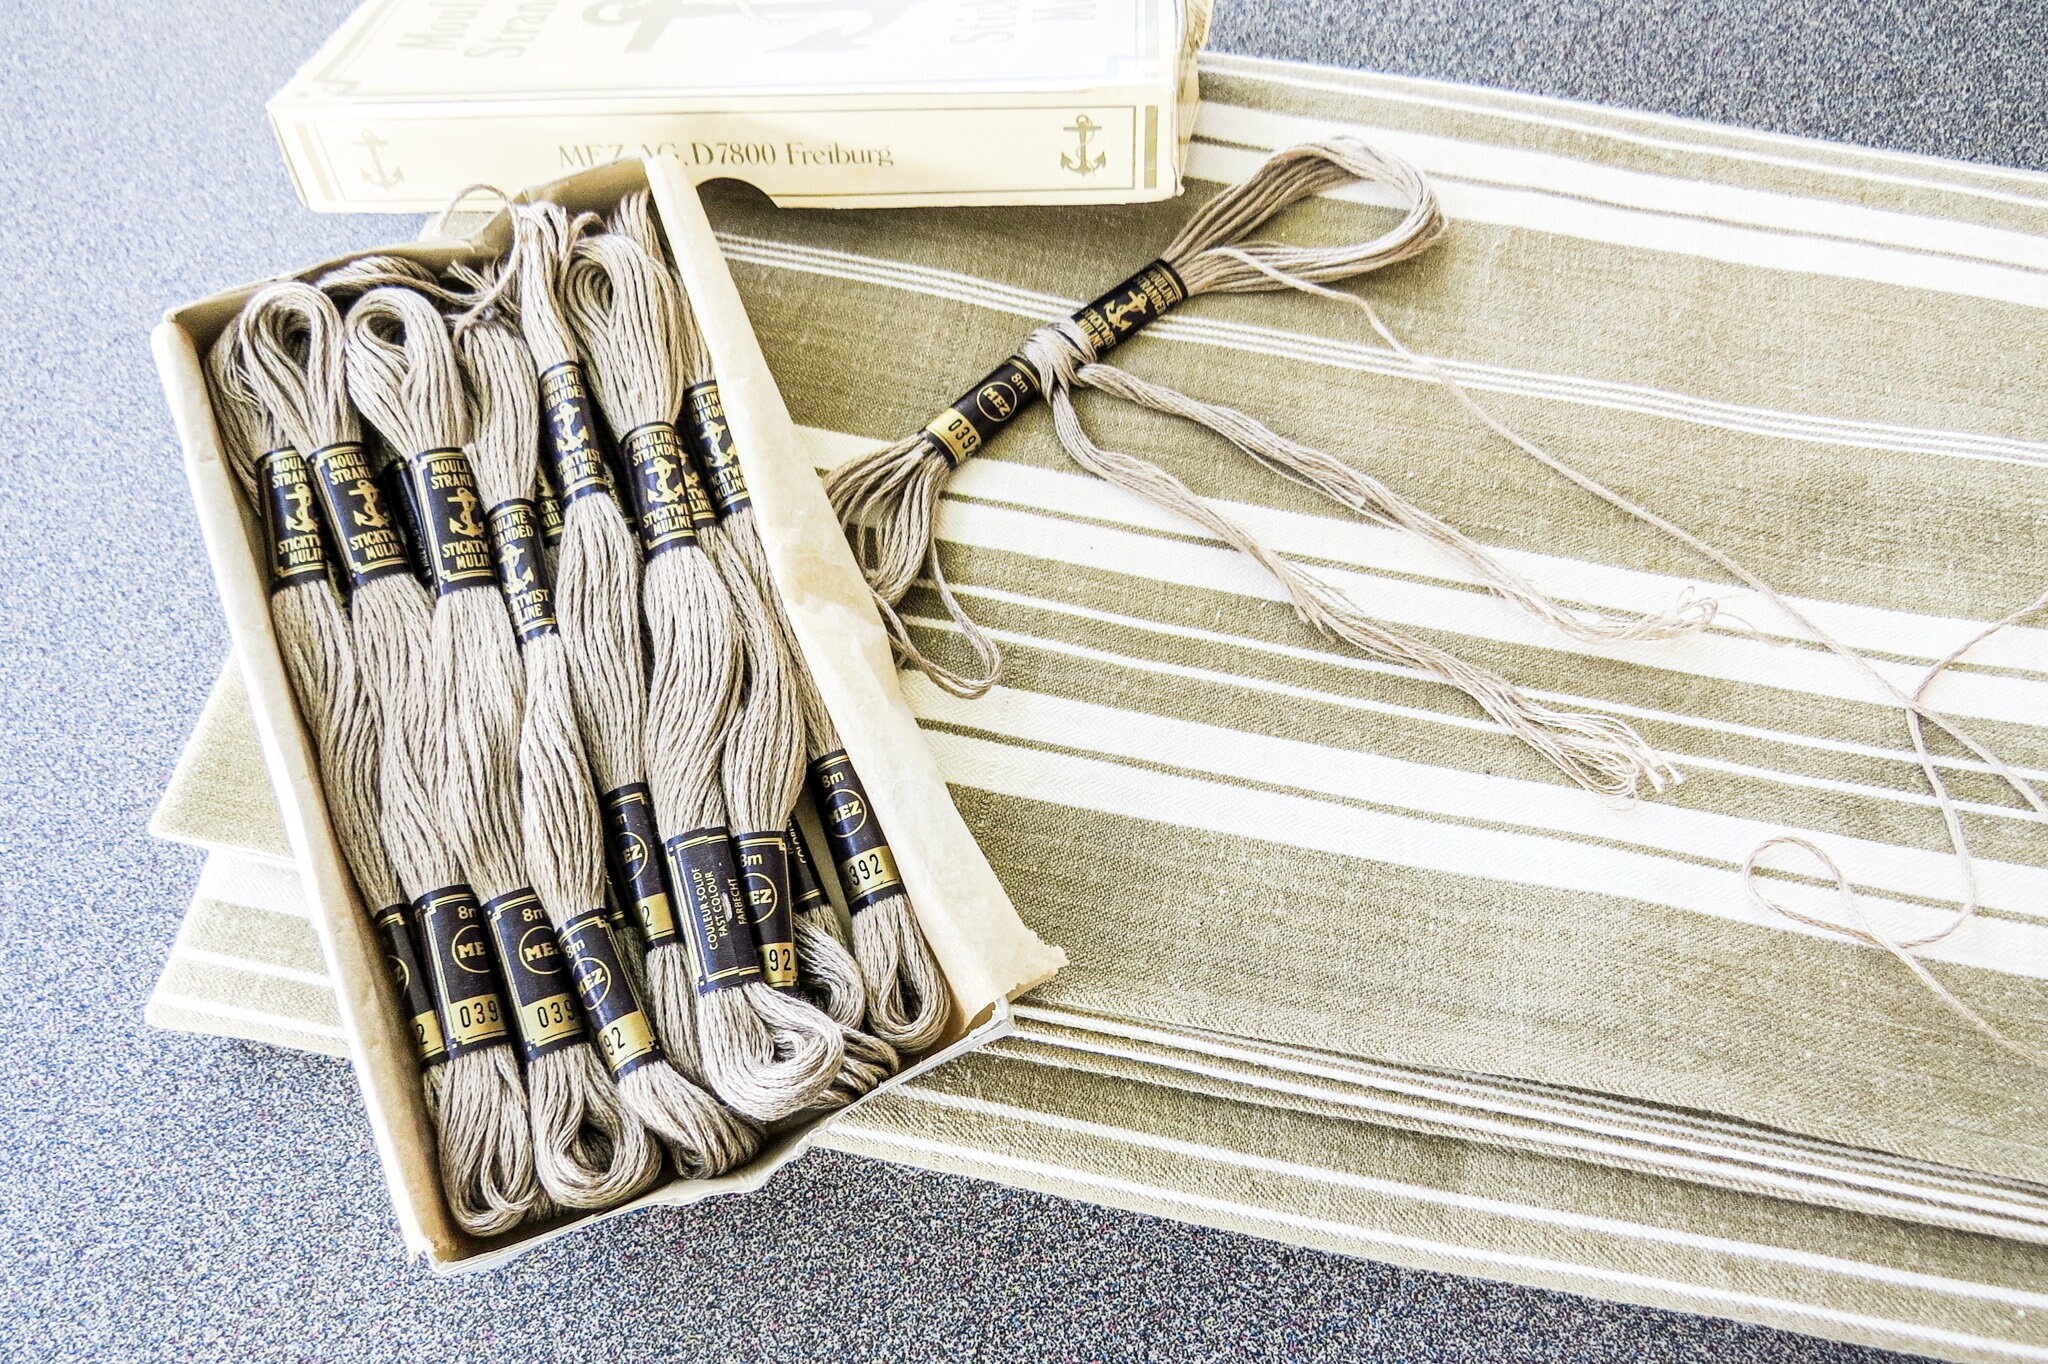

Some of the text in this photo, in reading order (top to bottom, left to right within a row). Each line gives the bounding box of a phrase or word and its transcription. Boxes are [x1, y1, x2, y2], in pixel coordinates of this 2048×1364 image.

[396, 0, 488, 50] Moul
[464, 0, 558, 59] Stran
[692, 141, 777, 167] D7800
[786, 141, 894, 169] Freiburg
[1011, 372, 1029, 394] 8m
[693, 391, 721, 411] ULIN
[982, 387, 1011, 417] MEZ
[272, 456, 306, 475] MOUL
[328, 453, 366, 472] MOULI
[430, 459, 468, 475] MOULI
[633, 443, 679, 467] STRANDE
[272, 469, 308, 489] STRAN
[492, 510, 529, 536] OULINE
[643, 503, 691, 529] STICKTWI
[364, 542, 401, 561] MULIN
[441, 540, 489, 559] STICKTW
[821, 771, 845, 788] 8m
[623, 843, 643, 864] EZ
[848, 853, 883, 887] 392
[704, 870, 729, 938] FAST COLOUR
[727, 878, 748, 926] FARBECHT
[748, 888, 773, 906] EZ
[700, 902, 719, 951] COULEUR
[457, 941, 486, 959] ME
[523, 942, 559, 962] ME
[565, 938, 586, 959] 8m
[769, 948, 792, 972] 92
[460, 1000, 499, 1028] 039
[537, 1001, 575, 1028] 039
[603, 1026, 626, 1056] 92
